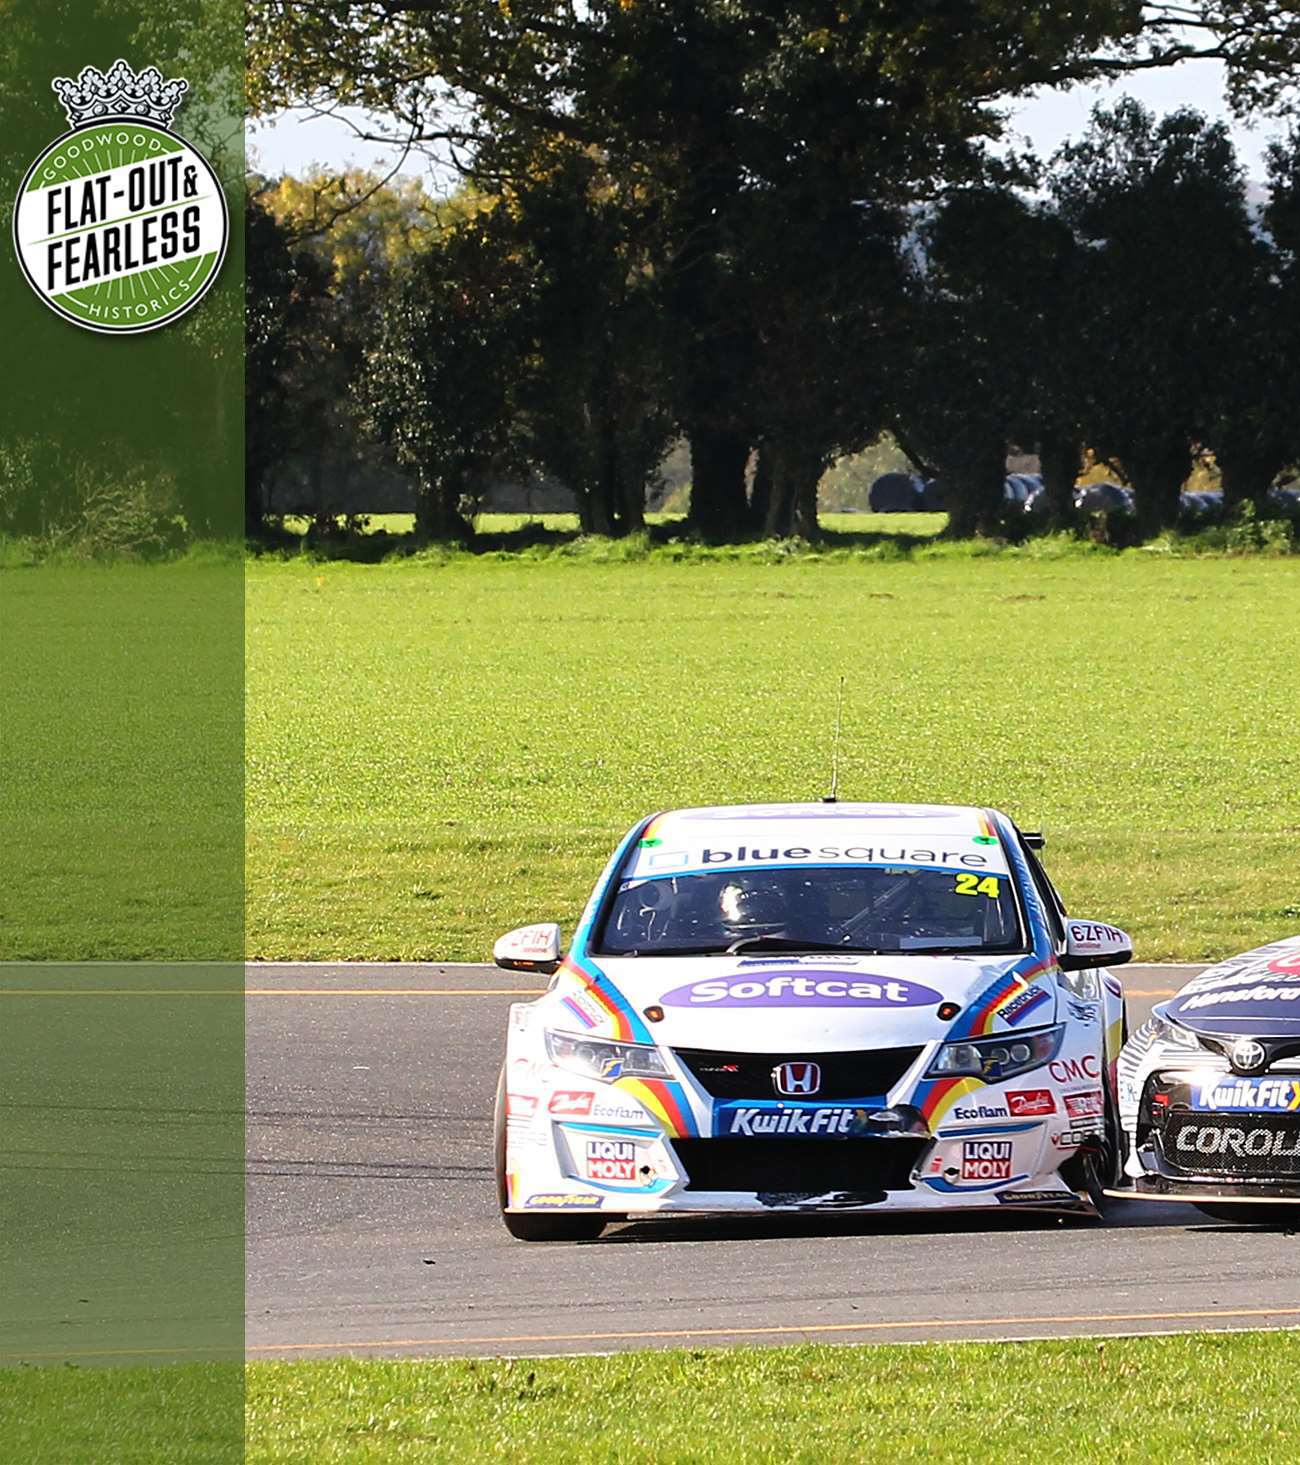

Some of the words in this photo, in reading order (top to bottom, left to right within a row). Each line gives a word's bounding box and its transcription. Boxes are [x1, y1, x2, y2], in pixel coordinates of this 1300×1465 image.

[954, 872, 1000, 898] 24
[690, 976, 909, 1003] Softcat
[1049, 1056, 1100, 1084] CMC
[953, 1105, 1008, 1120] Ecoflam
[588, 1143, 635, 1160] LIQUI
[964, 1142, 1011, 1160] LIQUI
[588, 1160, 635, 1178] MOLY
[963, 1161, 1011, 1178] MOLY
